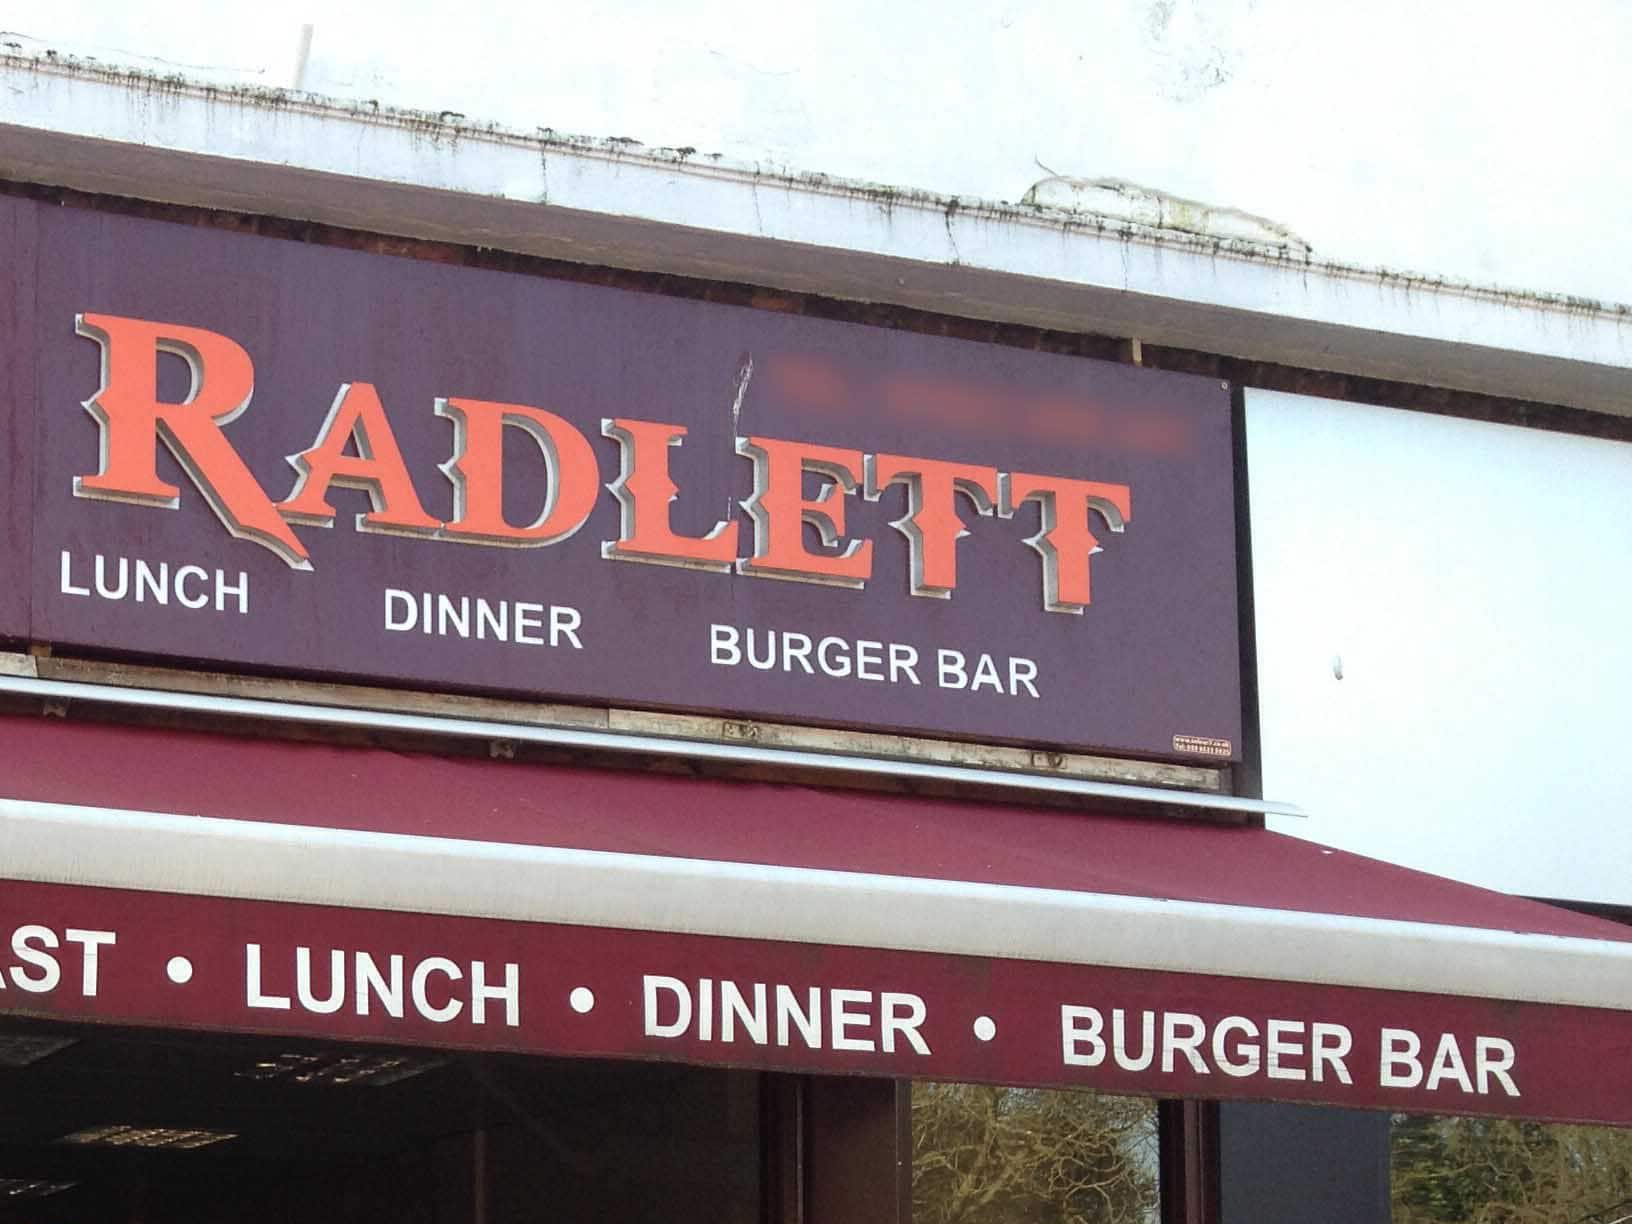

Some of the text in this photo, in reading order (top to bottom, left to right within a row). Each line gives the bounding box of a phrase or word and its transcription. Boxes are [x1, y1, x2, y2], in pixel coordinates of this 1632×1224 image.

[74, 312, 1131, 615] RADLETT
[61, 551, 1039, 697] LUNCH DINNER BURGER BAR
[247, 944, 519, 1026] LUNCH
[644, 975, 931, 1055] DINNER
[1062, 1005, 1352, 1084] BURGER
[1381, 1028, 1520, 1096] BAR
